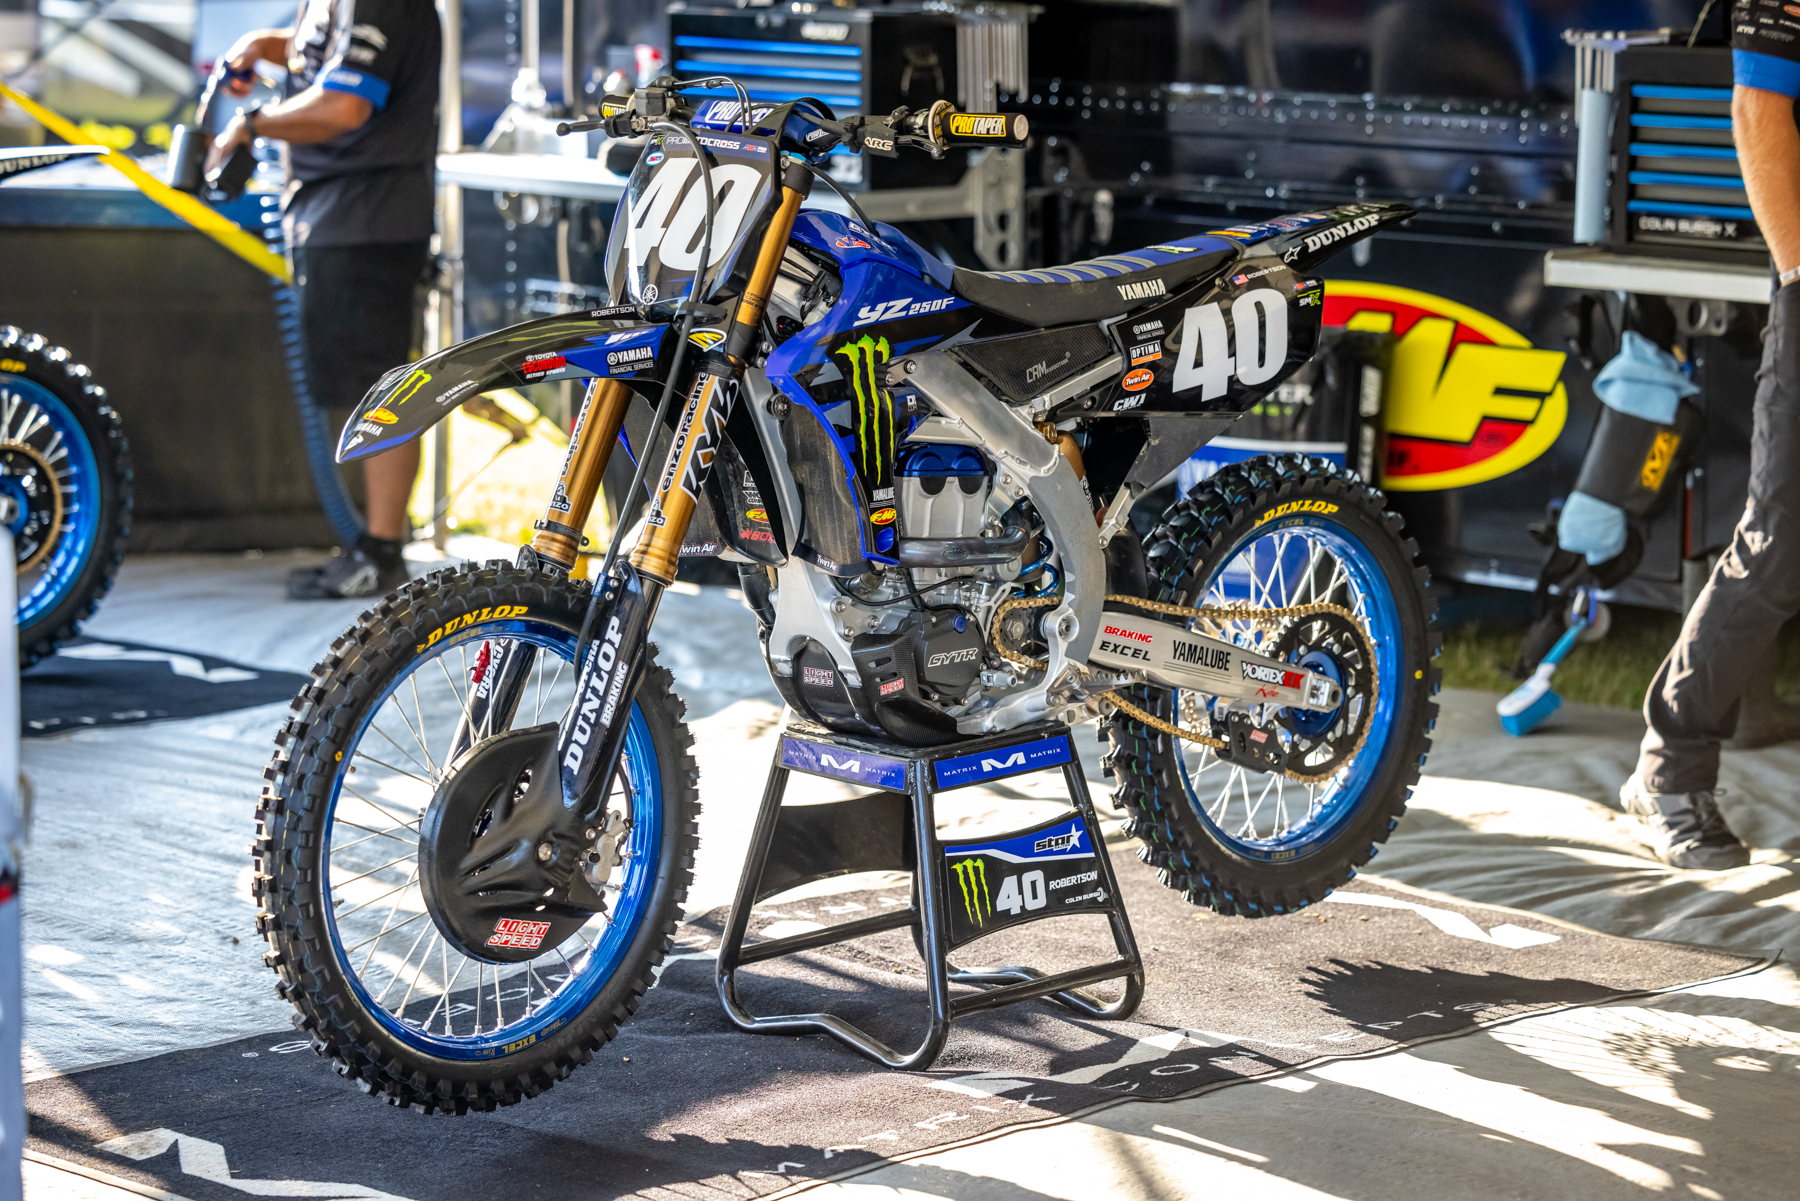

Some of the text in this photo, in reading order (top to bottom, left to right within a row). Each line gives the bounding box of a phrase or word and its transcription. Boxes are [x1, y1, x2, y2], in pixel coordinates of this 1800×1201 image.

[953, 115, 1003, 136] PROTAPER
[864, 136, 894, 151] ARC
[623, 157, 763, 271] 40
[1304, 213, 1381, 253] DUNLOP
[1247, 264, 1287, 280] ROBERTSON
[1117, 278, 1167, 301] YAMAHA
[1299, 292, 1321, 307] SMX
[591, 305, 636, 318] ROBERTSON
[852, 296, 956, 328] YZ 250F
[616, 346, 654, 363] YAMAHA
[1131, 343, 1160, 359] OPTIMA
[1171, 287, 1289, 403] 40
[522, 355, 567, 374] ESCONDIDO
[534, 351, 558, 361] TOYOTA
[546, 367, 567, 377] SPORTS
[609, 360, 654, 376] FINANCIAL SERVICES
[1026, 359, 1047, 384] CRM
[1126, 371, 1152, 387] Twin Air
[679, 377, 739, 505] KYB
[870, 508, 897, 525] FMF
[1262, 499, 1340, 524] DUNLOP
[425, 604, 529, 649] DUNLOP
[449, 626, 484, 647] EXCEL
[1103, 625, 1154, 644] BRAKING
[927, 647, 979, 668] GYTR
[1099, 640, 1152, 662] EXCEL
[1172, 639, 1232, 672] YAMALUBE
[804, 667, 834, 680] LIGHT
[804, 676, 834, 688] SPEED
[1241, 660, 1287, 687] VORTEX
[600, 661, 629, 726] BRAKING
[880, 678, 904, 691] LIGHT
[563, 615, 624, 776] DUNLOP
[788, 750, 817, 761] MATRIX
[865, 767, 896, 778] MATRIX
[943, 765, 978, 778] MATRIX
[1029, 747, 1062, 759] MATRIX
[1035, 834, 1074, 852] star
[1049, 870, 1098, 891] ROBERTSON
[995, 868, 1047, 916] 40
[1065, 894, 1083, 904] COLIN
[496, 918, 551, 936] LIGHT
[488, 934, 543, 949] SPEED
[501, 1034, 537, 1054] EXCEL
